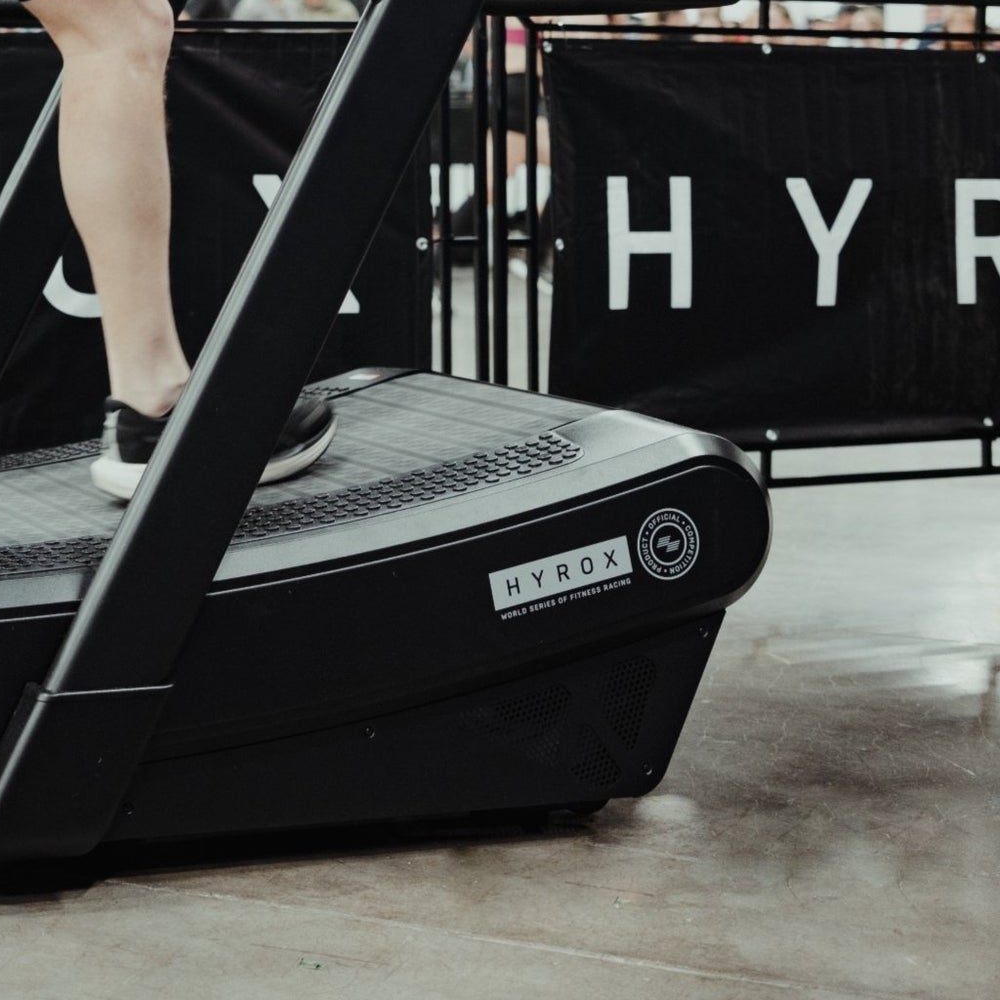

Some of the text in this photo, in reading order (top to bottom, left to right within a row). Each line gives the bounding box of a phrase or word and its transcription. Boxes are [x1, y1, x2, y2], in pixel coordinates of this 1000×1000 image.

[606, 176, 1000, 310] HYR
[641, 513, 695, 574] OFFICIAL COMPETITION PRODUCT
[500, 577, 632, 620] WORLD SERIES OF FITNESS RACING
[505, 549, 618, 597] HYROX
